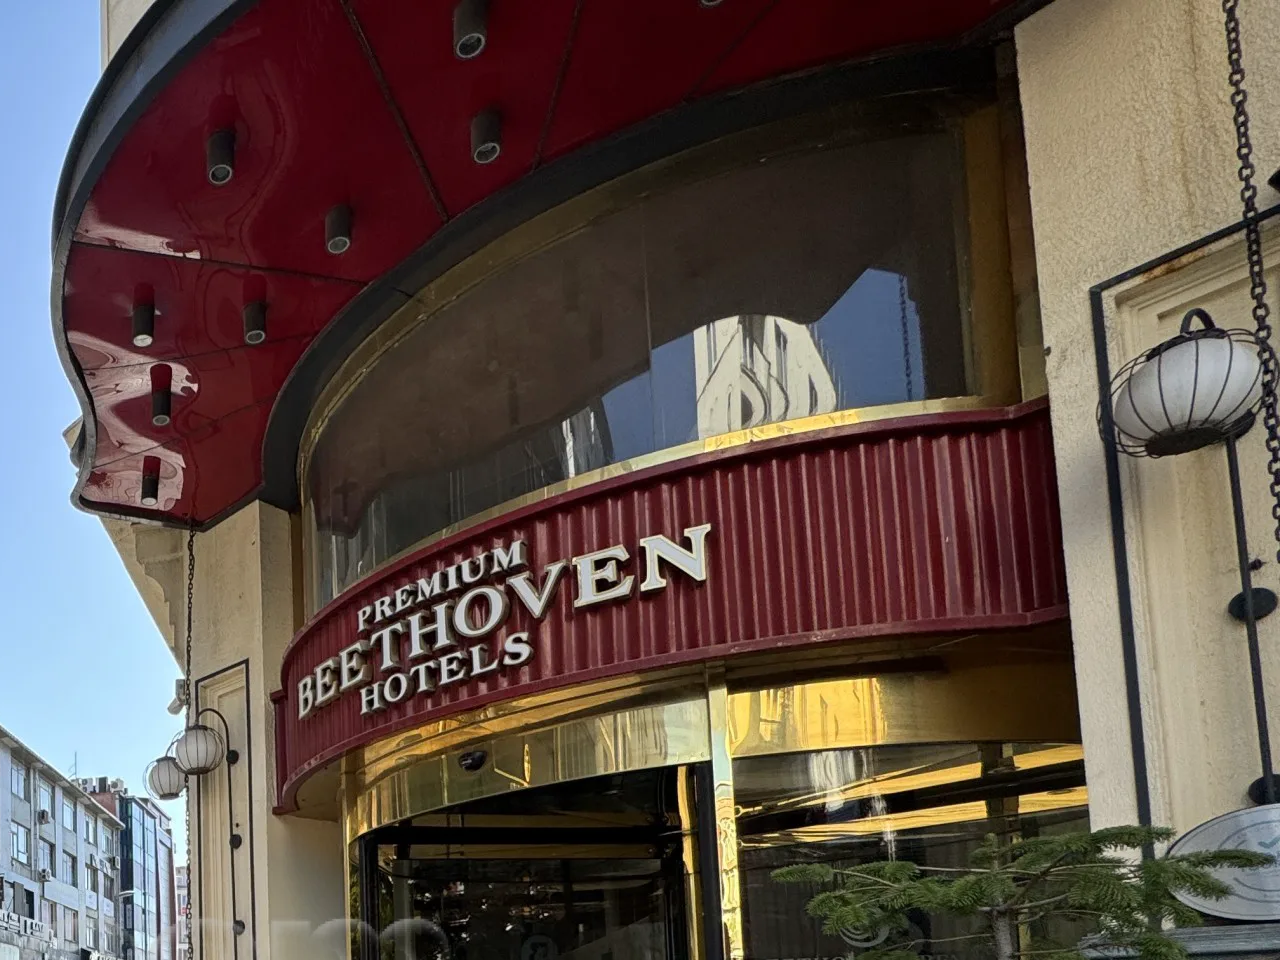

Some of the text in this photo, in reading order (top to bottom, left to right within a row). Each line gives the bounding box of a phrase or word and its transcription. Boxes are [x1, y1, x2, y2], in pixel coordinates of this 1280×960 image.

[298, 523, 712, 720] BEETHOVEN
[357, 540, 528, 634] PREMIUM
[360, 632, 533, 716] HOTELS
